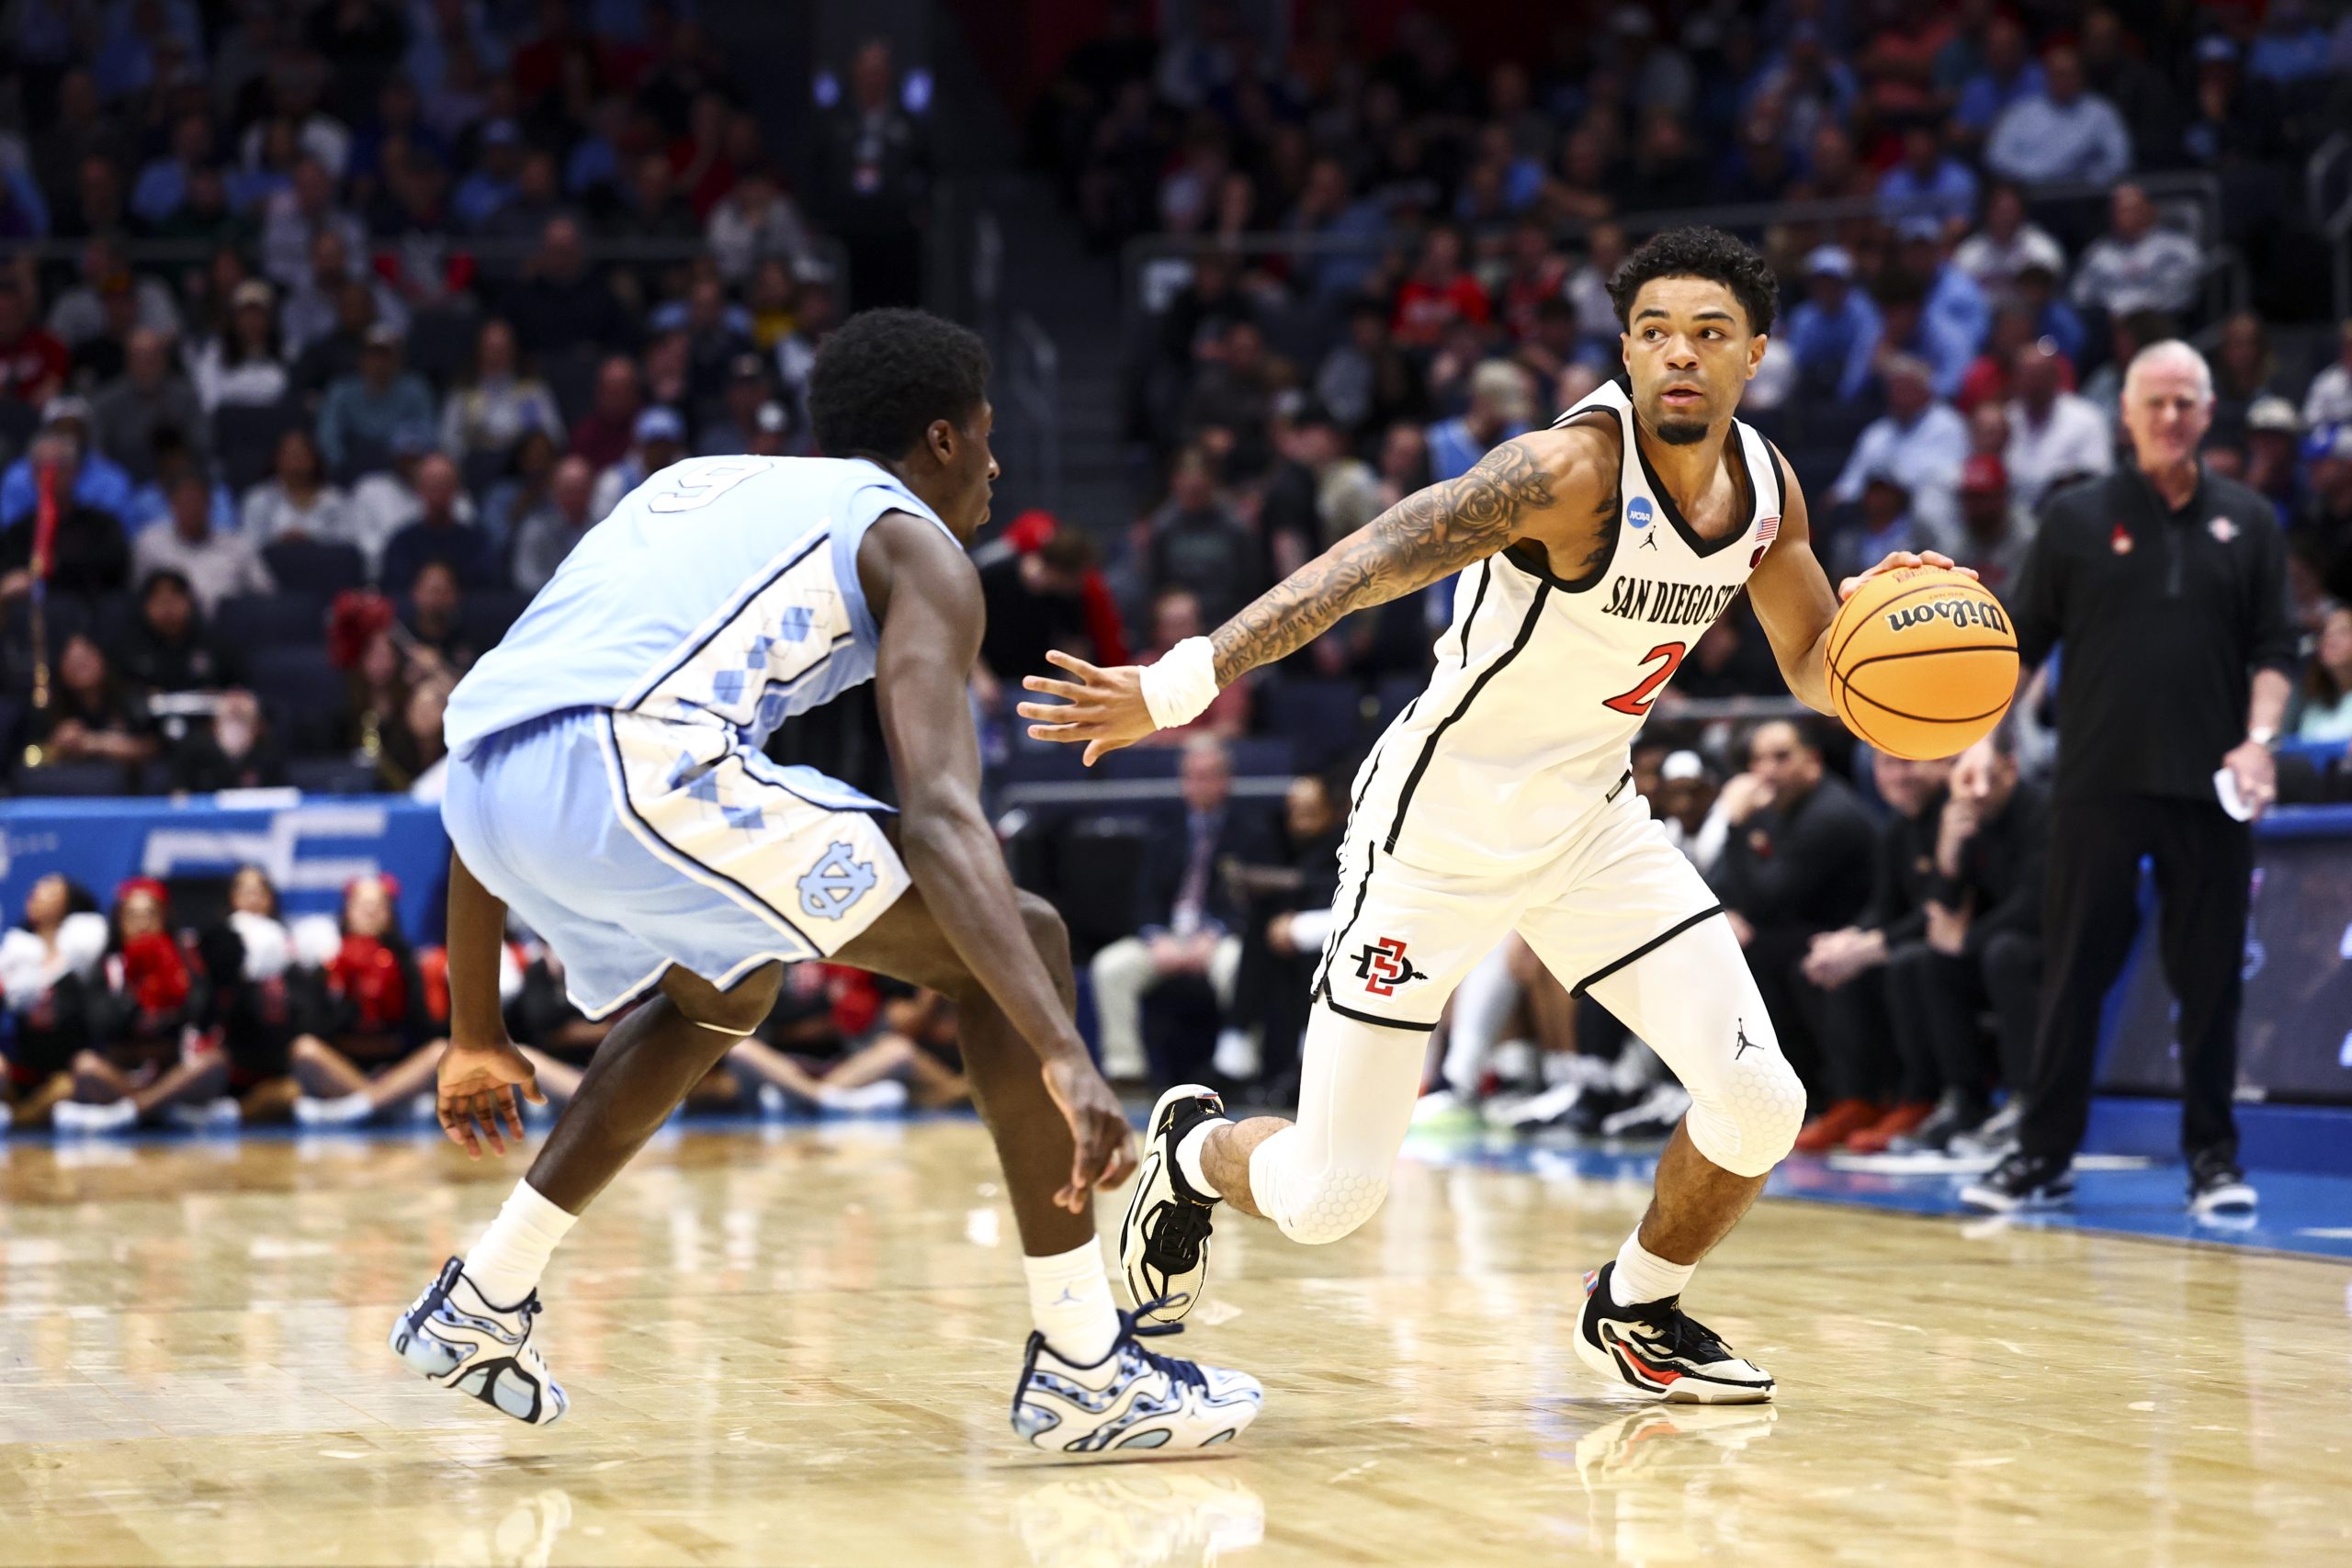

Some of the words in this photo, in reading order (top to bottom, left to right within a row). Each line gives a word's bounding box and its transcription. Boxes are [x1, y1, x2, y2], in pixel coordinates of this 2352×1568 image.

[648, 459, 775, 513] 9
[1629, 510, 1651, 522] NCAA
[1601, 575, 1653, 621] SAN
[1647, 581, 1713, 626] DIEGO
[1886, 600, 2008, 635] Wilson
[1601, 641, 1687, 716] 2
